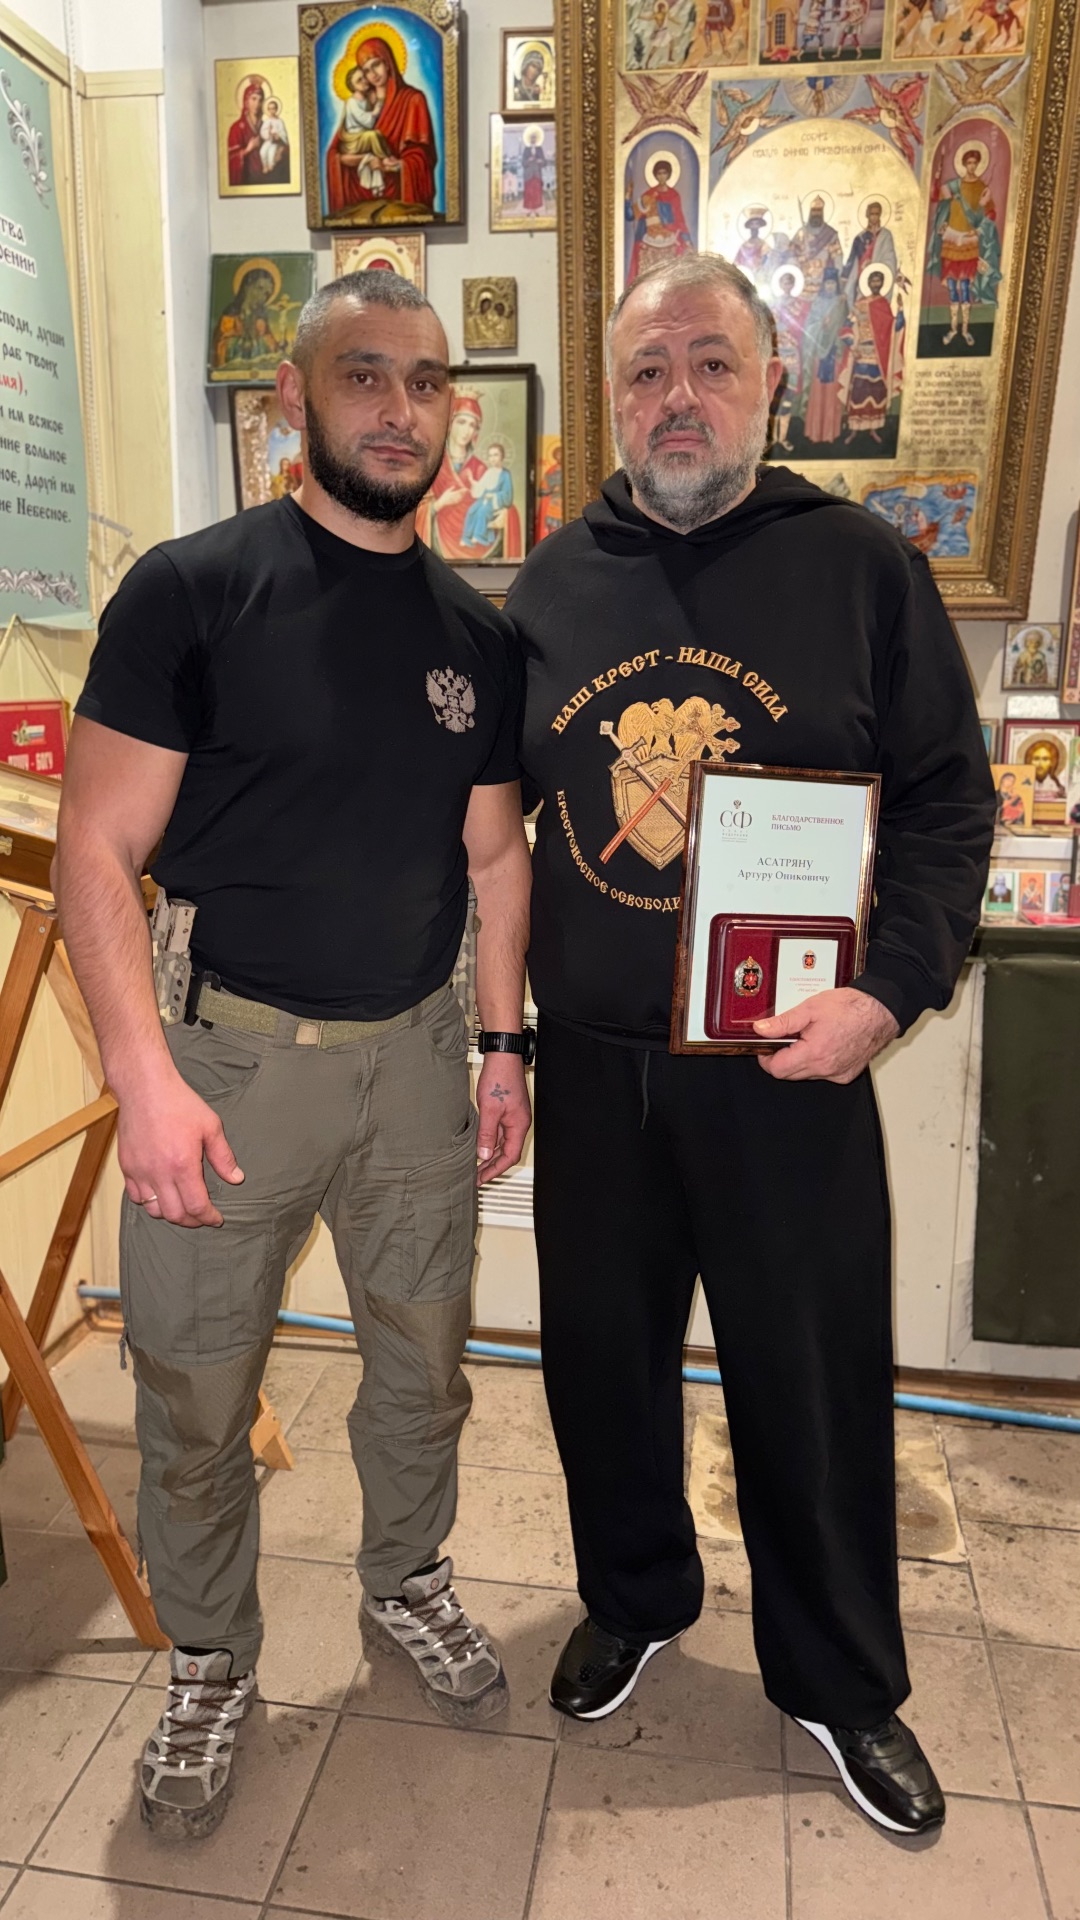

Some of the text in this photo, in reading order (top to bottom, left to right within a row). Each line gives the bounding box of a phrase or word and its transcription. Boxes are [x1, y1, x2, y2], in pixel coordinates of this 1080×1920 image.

[2, 343, 22, 361] раб
[8, 407, 25, 424] им
[28, 413, 64, 435] всякое
[25, 443, 67, 465] вольное
[25, 473, 57, 495] даруй
[60, 481, 76, 495] им
[17, 497, 72, 523] Небесное.
[551, 686, 594, 735] НАШ
[591, 649, 660, 693] КРЕСТ
[677, 646, 743, 679] НАША
[742, 671, 789, 723] СИЛА
[720, 810, 753, 829] СФ
[771, 814, 845, 826] БЛАГОДАРСТВЕННОЕ
[771, 823, 801, 832] ПИСЬМО
[556, 789, 609, 893] КРЕСТОНОСНОЕ
[757, 857, 814, 871] АСАТРЯНУ
[737, 869, 830, 885] Артуру Ониковичу
